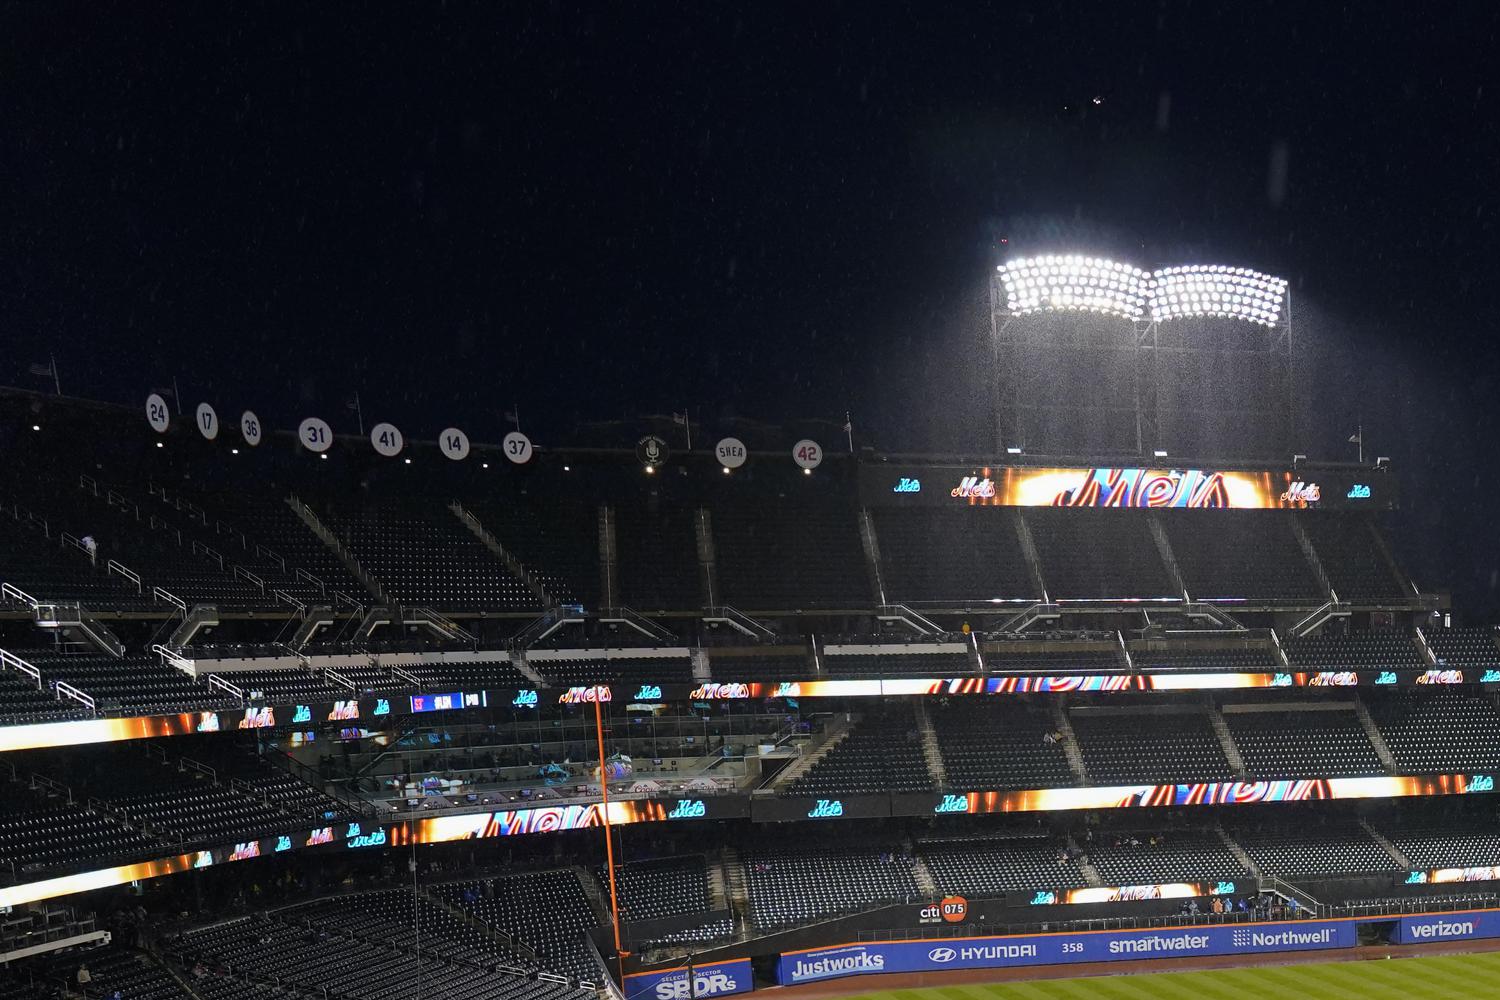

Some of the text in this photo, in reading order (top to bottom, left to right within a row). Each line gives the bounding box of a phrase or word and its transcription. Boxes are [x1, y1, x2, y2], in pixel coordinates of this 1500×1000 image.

[149, 402, 165, 423] 24
[202, 411, 212, 430] 17
[245, 420, 257, 437] 36
[308, 426, 324, 443] 31
[379, 431, 395, 447] 41
[447, 435, 460, 450] 14
[508, 440, 526, 455] 37
[719, 446, 743, 458] SHEA
[798, 447, 817, 461] 42
[951, 477, 996, 498] Mets
[1281, 481, 1321, 502] Mets
[920, 906, 940, 919] citi
[944, 904, 964, 914] 075
[1411, 920, 1473, 938] verizon
[1109, 934, 1209, 953] smartwater
[1252, 929, 1330, 947] Northwell
[961, 944, 1037, 960] HYUNDAI
[1062, 942, 1084, 953] 358
[792, 951, 884, 977] Justworks
